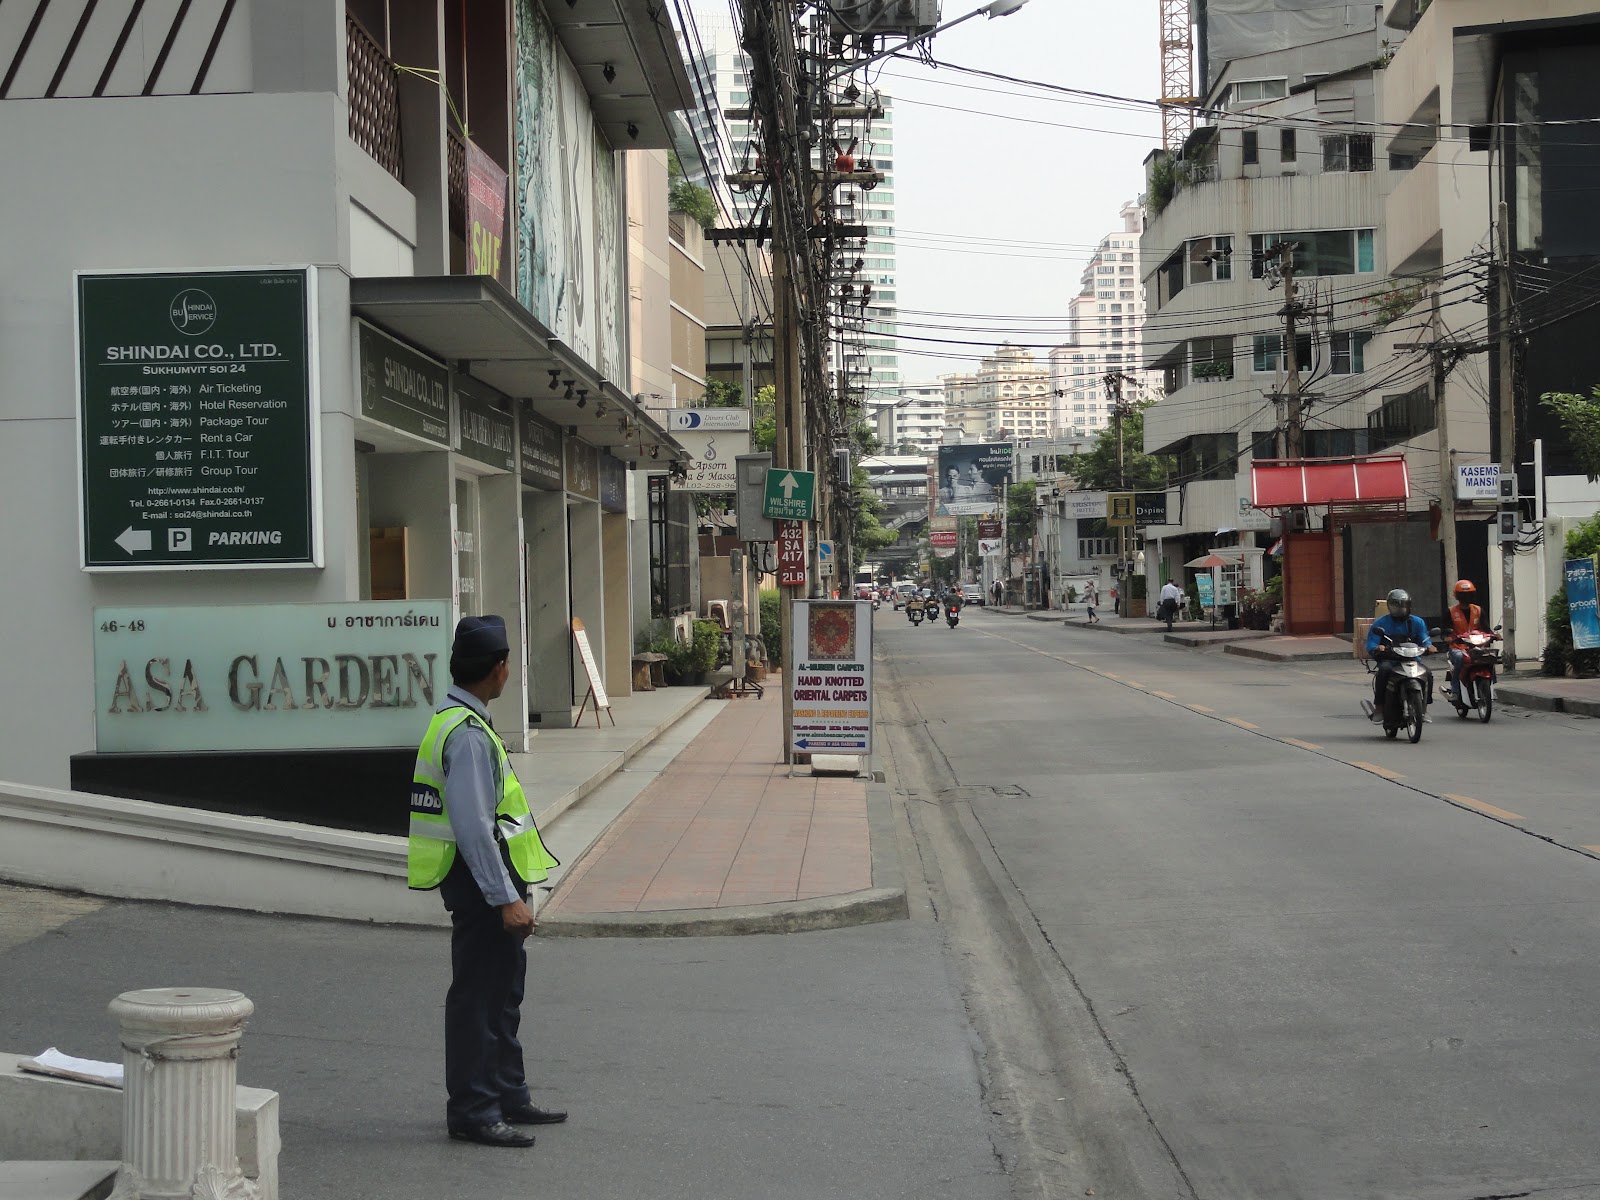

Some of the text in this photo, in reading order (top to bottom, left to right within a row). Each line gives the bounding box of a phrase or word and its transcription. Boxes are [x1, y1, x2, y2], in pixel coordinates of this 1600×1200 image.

[106, 344, 282, 360] SHINDAI CO., LTD.
[142, 366, 207, 375] SUKHUMVIT
[230, 364, 246, 373] 24
[384, 356, 416, 398] SHINDAI
[200, 383, 262, 394] Air Ticketing
[200, 400, 287, 410] Hotel Reservation
[200, 416, 268, 427] Package Tour
[100, 435, 192, 446] 運転手付きレンタカー
[200, 434, 224, 442] Rent
[235, 433, 253, 442] Car
[155, 450, 192, 460] 個人旅行
[200, 450, 249, 459] F.I.T. Tour
[200, 466, 258, 478] Group Tour
[696, 462, 727, 472] Apsorn
[696, 472, 705, 480] &
[708, 472, 737, 483] Massa
[1466, 477, 1497, 487] MANSI
[148, 486, 245, 496] http://www.shindai.co.th/
[146, 498, 196, 507] 0-2661-0134
[200, 498, 264, 506] Fax.0-2661-0137
[770, 497, 806, 508] WILSHIRE
[142, 511, 167, 520] E-mail
[174, 510, 252, 520] soi24@shindai.co.th
[796, 508, 806, 516] 22
[172, 530, 282, 548] P PARKING
[781, 529, 802, 539] 432
[785, 540, 800, 550] SA
[782, 551, 803, 562] 417
[782, 572, 804, 582] 2LB
[345, 610, 439, 627] อาซาการ์เดน
[100, 620, 145, 632] 46-48
[108, 654, 438, 713] ASA GARDEN
[798, 676, 864, 686] HAND KNOTTED
[794, 690, 867, 701] ORIENTAL CARPETS
[410, 790, 442, 808] ubb
